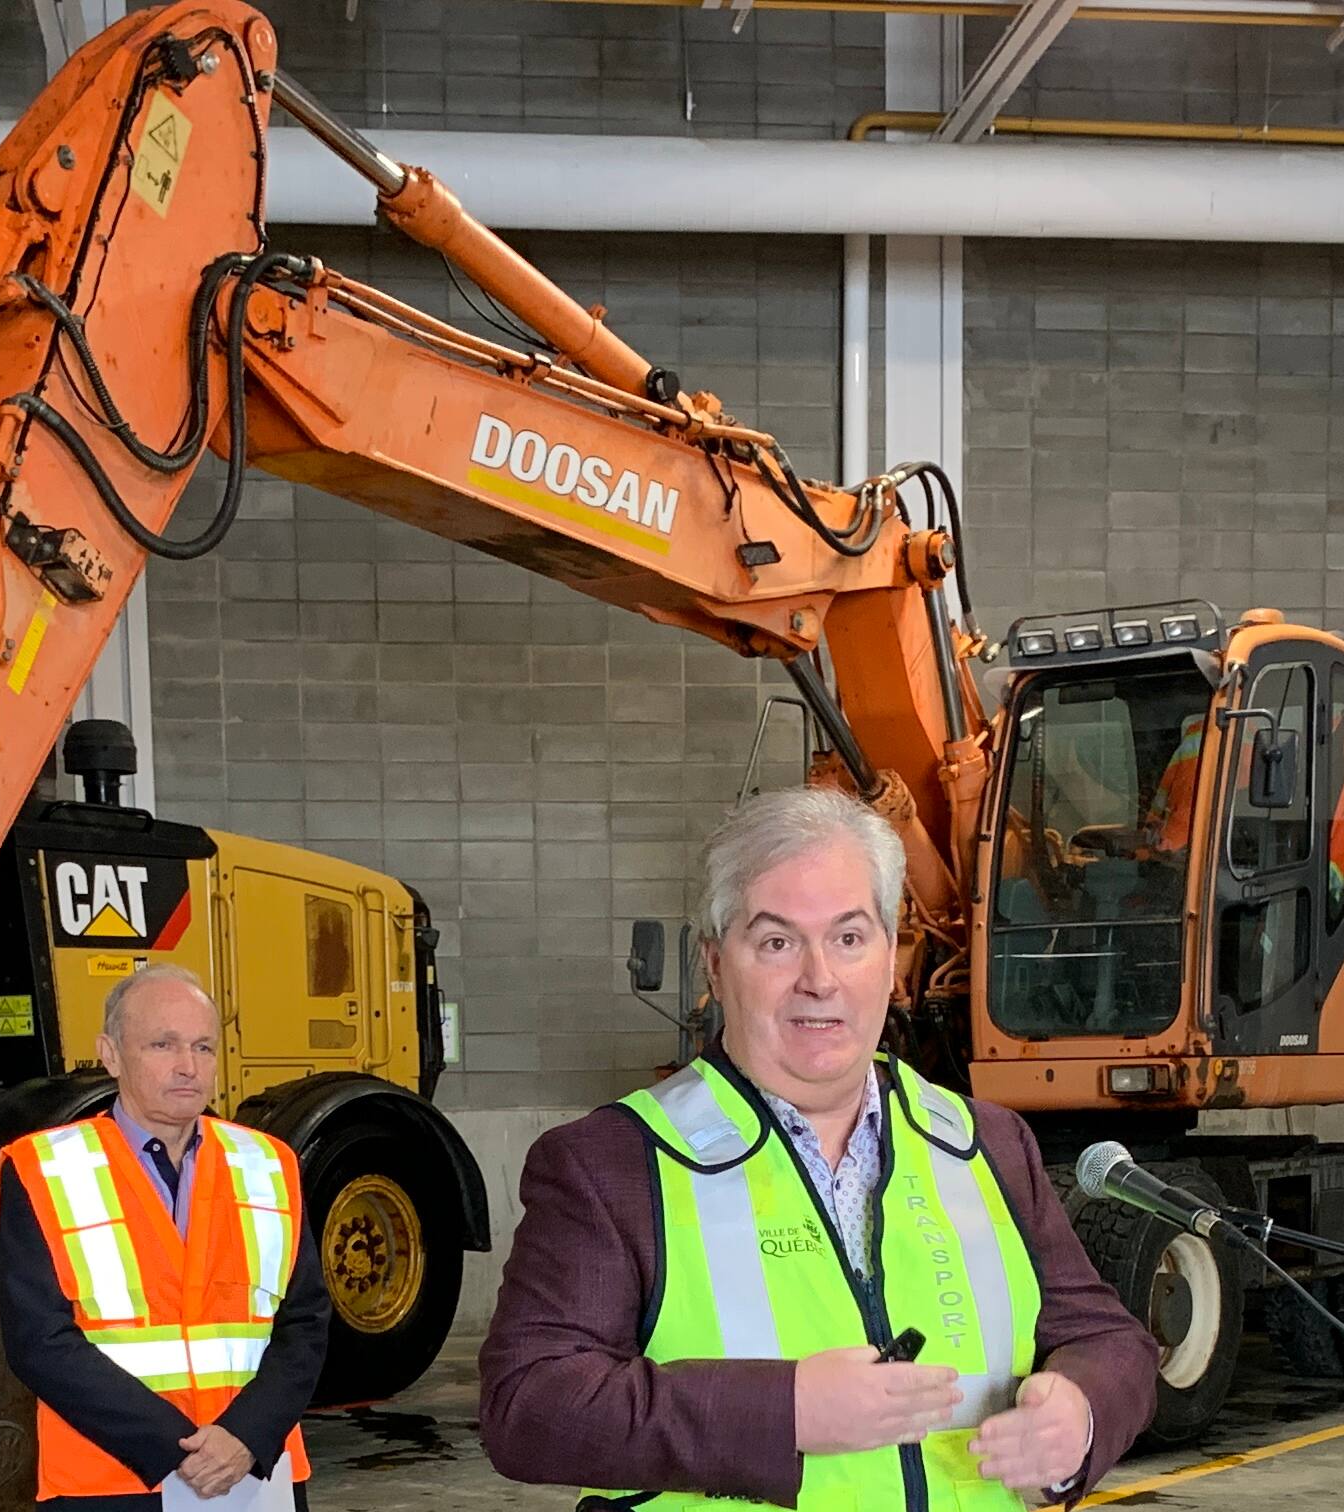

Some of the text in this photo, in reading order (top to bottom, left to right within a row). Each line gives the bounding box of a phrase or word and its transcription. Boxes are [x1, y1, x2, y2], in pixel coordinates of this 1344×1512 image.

[469, 411, 681, 535] DOOSAN
[56, 861, 149, 938] CAT
[903, 1175, 967, 1348] TRANSPORT
